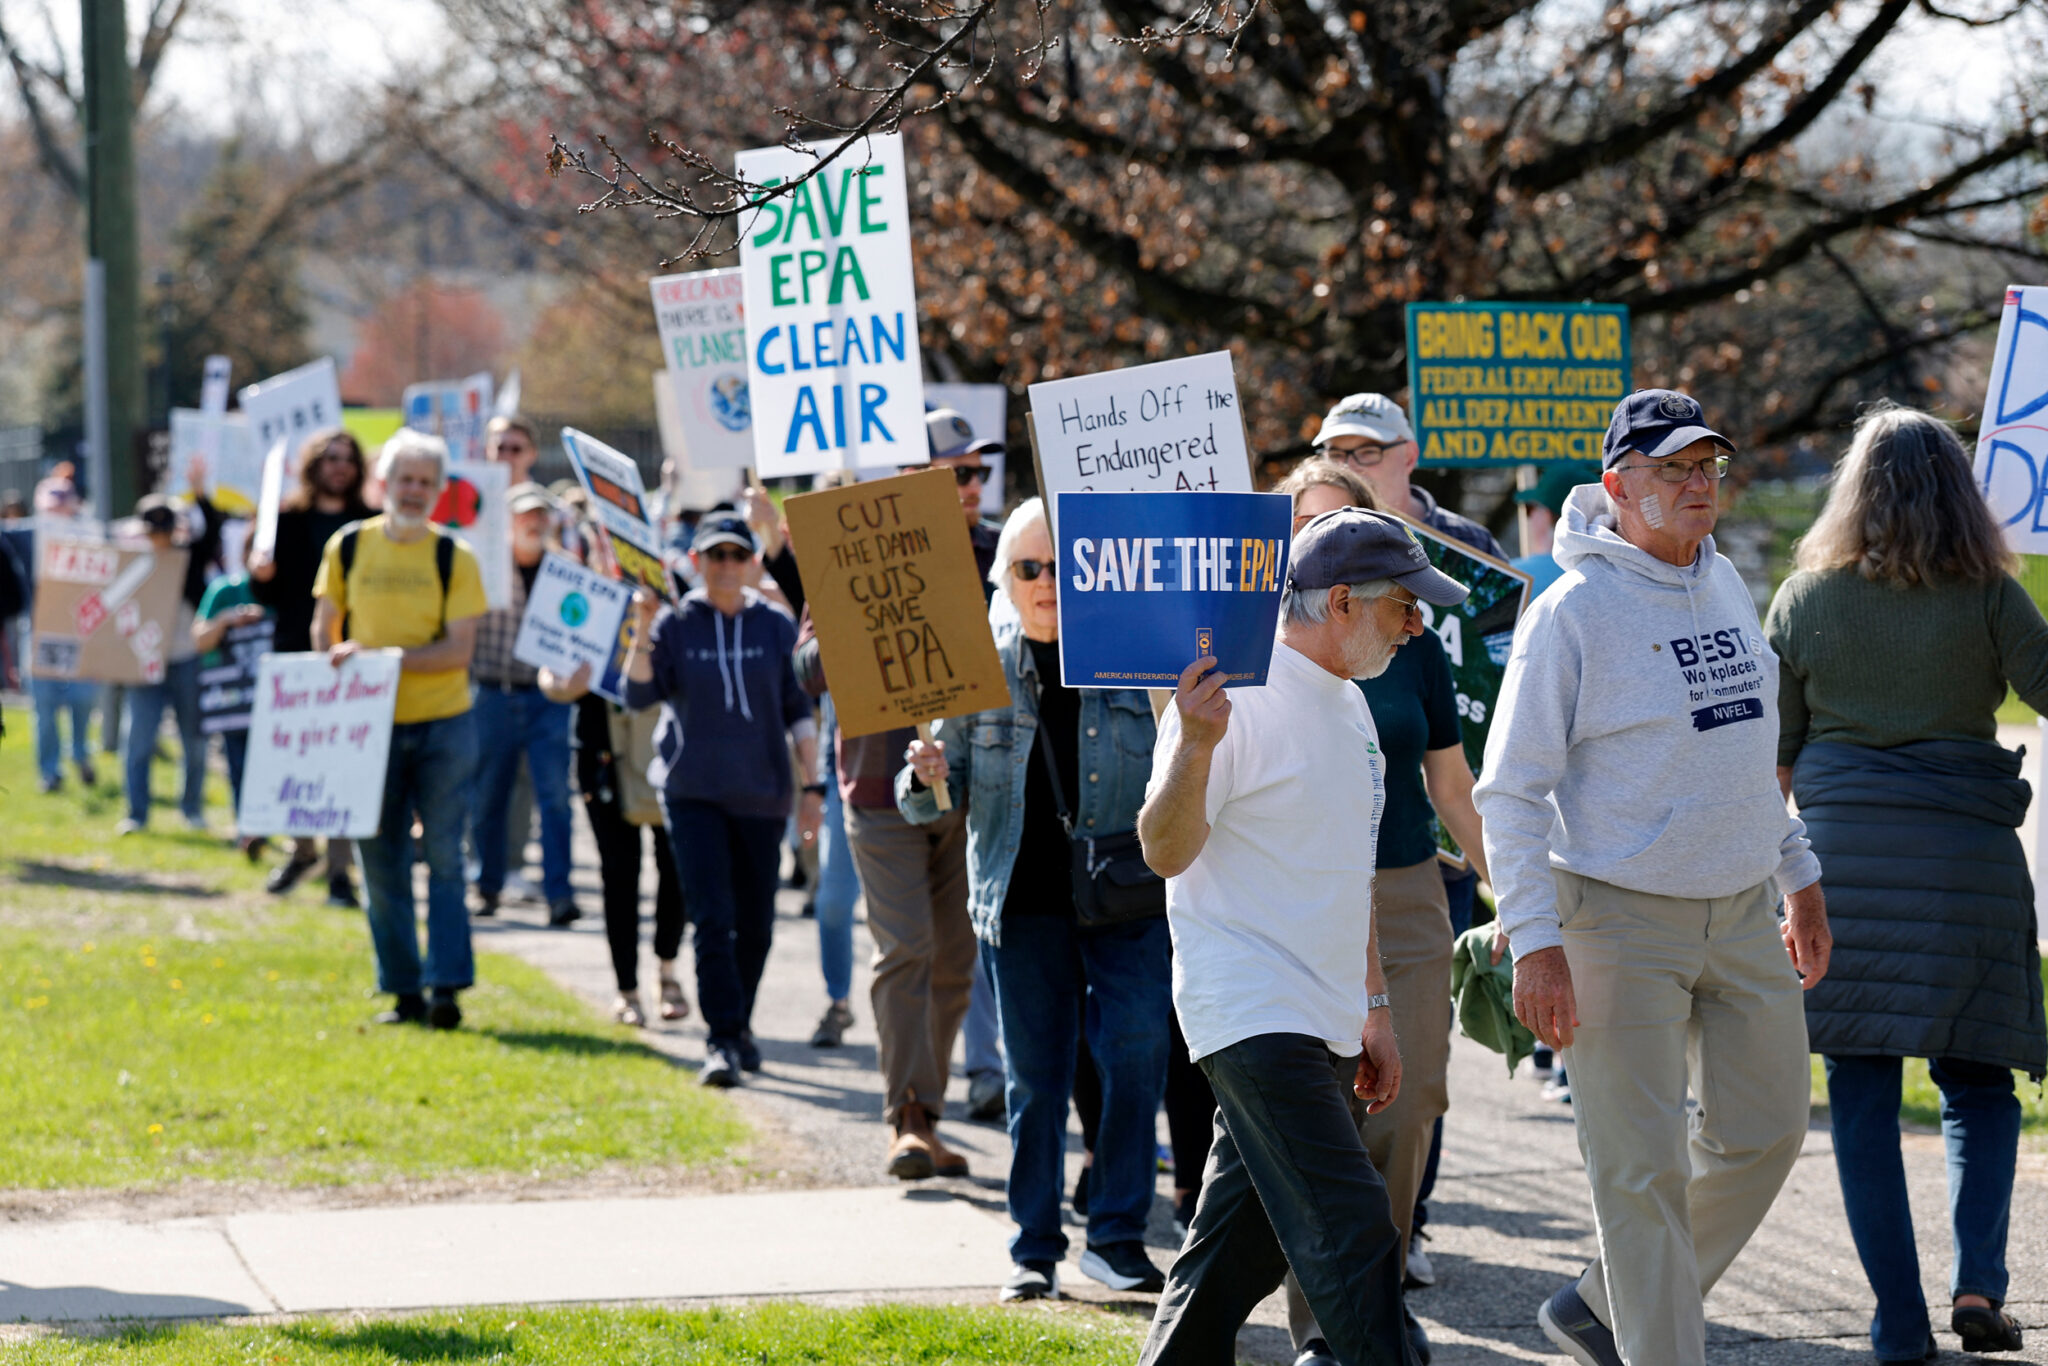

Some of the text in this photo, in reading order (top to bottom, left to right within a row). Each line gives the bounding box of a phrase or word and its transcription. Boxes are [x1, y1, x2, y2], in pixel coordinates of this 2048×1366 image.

[752, 165, 888, 248] SAVE
[660, 275, 743, 305] BECAUS
[770, 246, 871, 307] EPA
[756, 311, 905, 375] CLEAN
[1417, 311, 1622, 360] BRING BACK OUR
[1419, 366, 1624, 397] FEDERAL EMPLOYEES
[784, 383, 895, 454] AIR
[1058, 384, 1233, 434] Hands Off the
[1422, 399, 1617, 429] ALL DEPARTMENT
[1076, 422, 1218, 479] Endangered
[1423, 430, 1605, 460] AND AGENCI
[837, 493, 902, 532] CUT
[829, 527, 932, 569] THE DAMN
[1072, 537, 1284, 592] SAVE THE EPA!
[850, 562, 926, 604] CUTS
[864, 596, 926, 632] SAVE
[873, 622, 954, 694] EPA
[1669, 627, 1748, 668] BEST
[1094, 671, 1133, 680] AMERICAN
[1134, 672, 1178, 680] FEDERATION
[1682, 660, 1757, 685] Wokplaces
[1689, 689, 1704, 702] for
[1713, 702, 1752, 720] NVFEL
